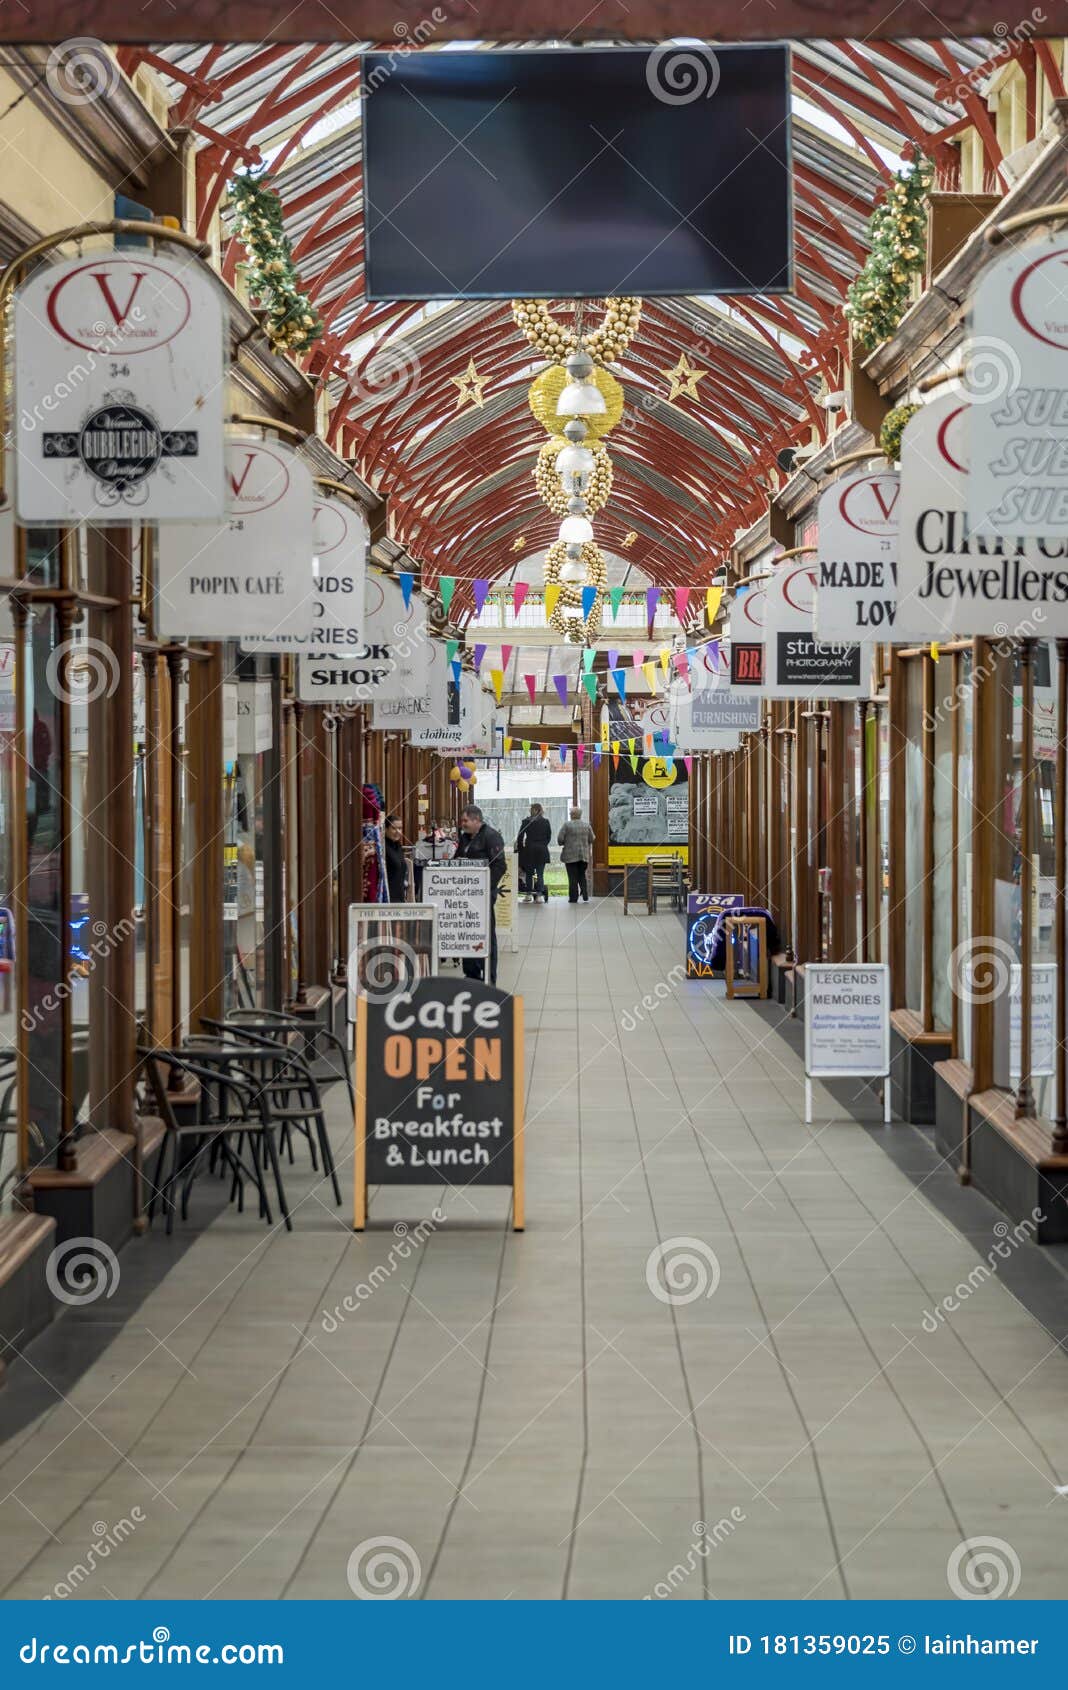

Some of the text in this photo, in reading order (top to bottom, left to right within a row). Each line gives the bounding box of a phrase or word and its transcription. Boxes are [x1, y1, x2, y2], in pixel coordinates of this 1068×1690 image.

[88, 272, 148, 326] V
[820, 562, 884, 587] MADE
[918, 560, 1068, 602] Jewellers
[189, 572, 284, 594] POPIN CAFÉ
[856, 600, 897, 626] LOV
[786, 658, 853, 667] PHOTOGRAPHY
[311, 669, 389, 685] SHOP
[692, 711, 757, 725] FURNISHING
[419, 727, 462, 741] clothing
[431, 874, 480, 885] Curtains
[444, 899, 469, 909] Nets
[695, 896, 736, 905] USA
[438, 912, 457, 920] rtain
[465, 911, 480, 920] Net
[439, 921, 481, 929] terations
[440, 941, 470, 951] Stickers
[816, 974, 878, 984] LEGENDS
[812, 995, 881, 1005] MEMORIES
[384, 991, 501, 1034] Cafe
[384, 1034, 502, 1081] OPEN
[416, 1087, 461, 1110] For
[375, 1114, 503, 1139] Breakfast
[386, 1143, 490, 1167] & Lunch
